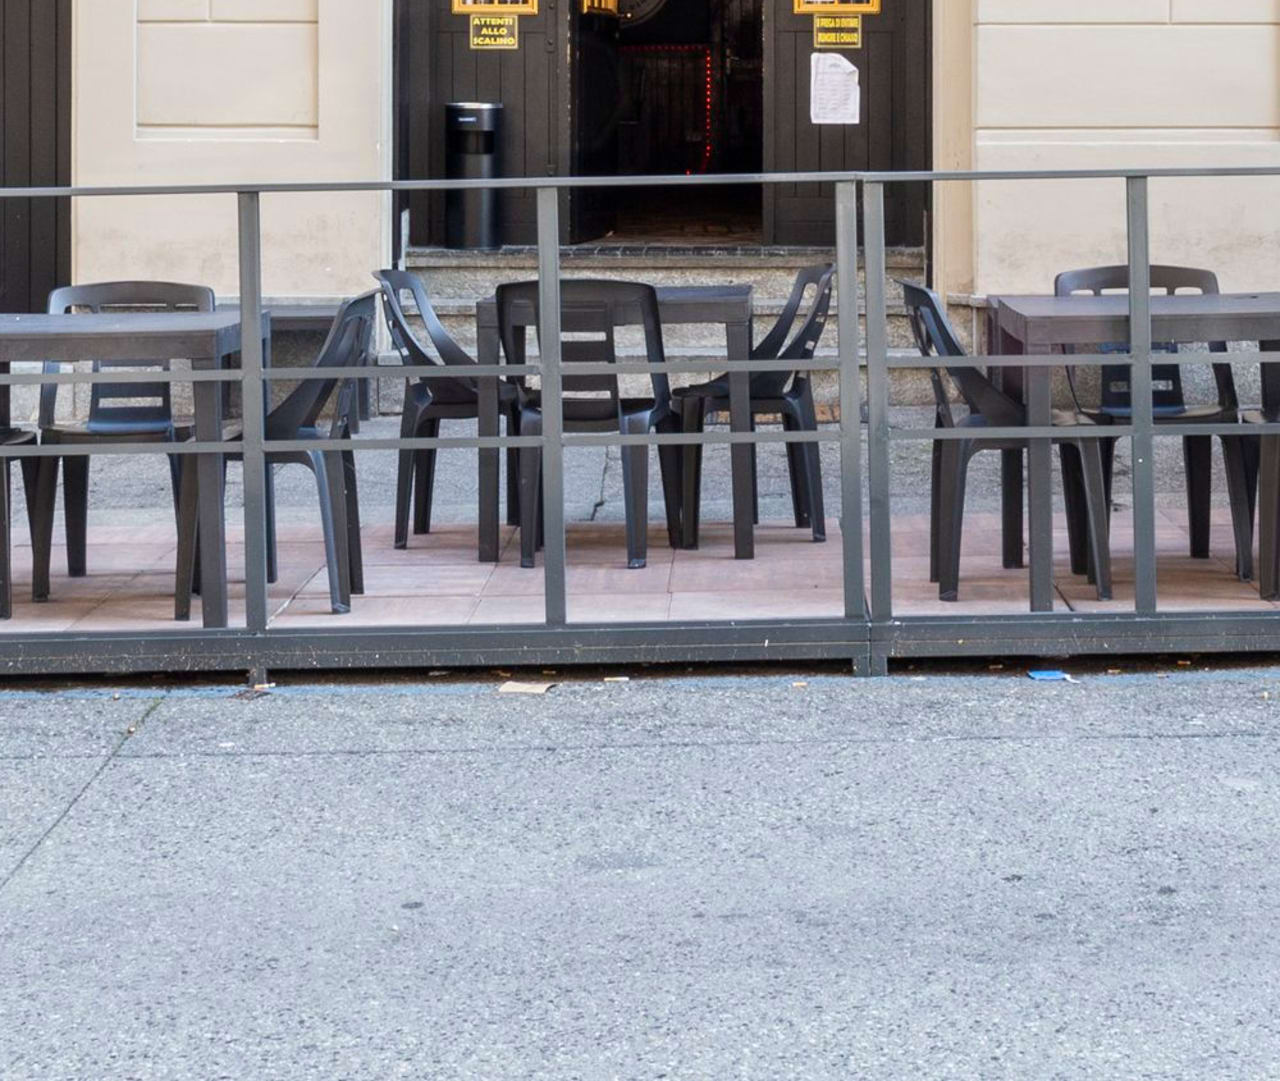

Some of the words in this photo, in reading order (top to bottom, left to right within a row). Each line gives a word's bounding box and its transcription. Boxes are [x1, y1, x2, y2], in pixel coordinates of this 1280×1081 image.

[473, 17, 513, 26] ATTENTI
[481, 27, 508, 35] ALLO
[473, 37, 515, 45] SCALINO
